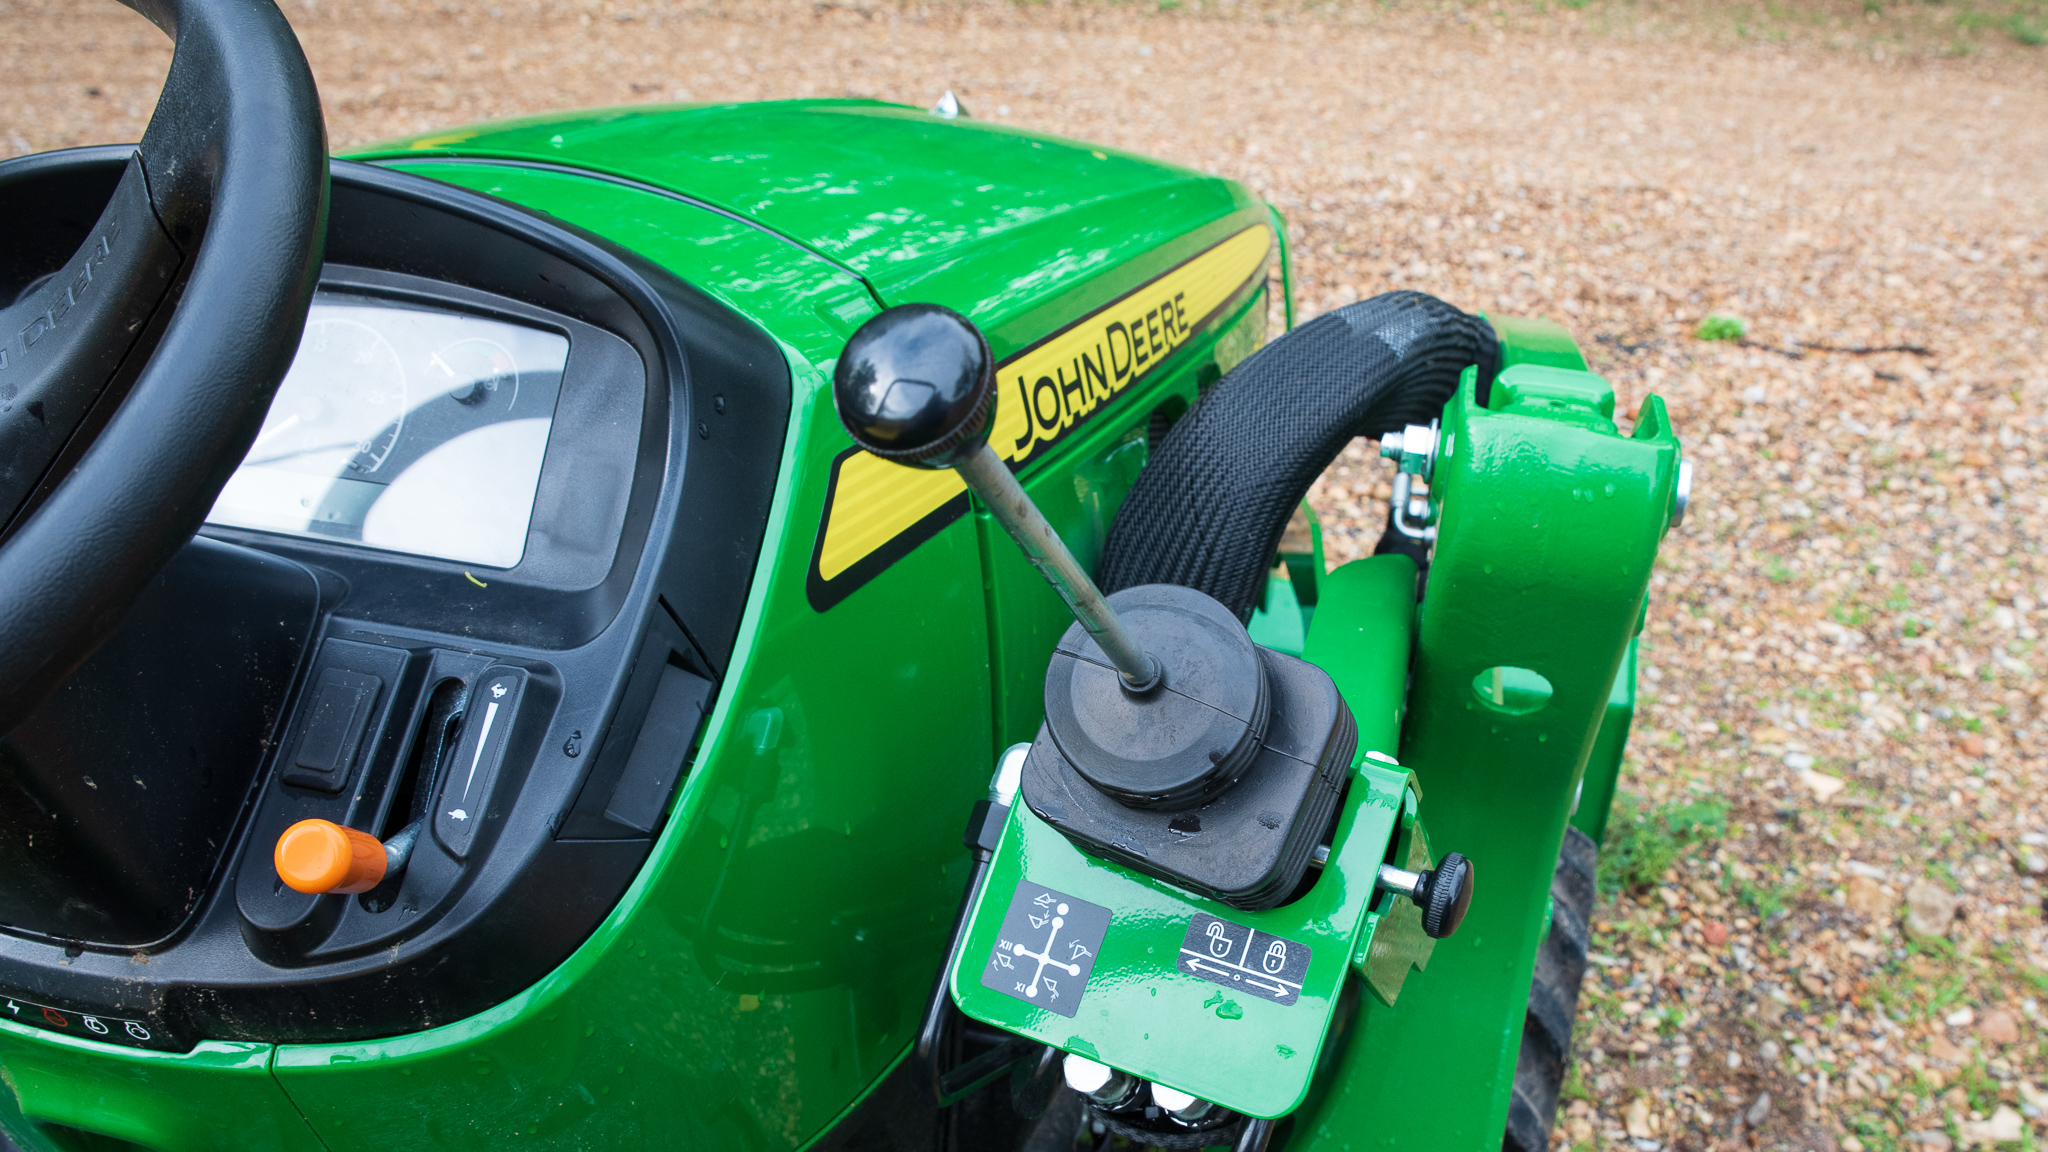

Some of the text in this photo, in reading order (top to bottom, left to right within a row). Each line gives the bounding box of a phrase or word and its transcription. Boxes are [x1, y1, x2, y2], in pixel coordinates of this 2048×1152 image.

[18, 215, 121, 355] DEERE
[352, 351, 373, 365] 20
[1015, 291, 1189, 451] JOHN DEERE
[366, 390, 387, 404] 25
[352, 439, 372, 454] 30
[998, 939, 1013, 951] XII
[1014, 981, 1026, 993] XI
